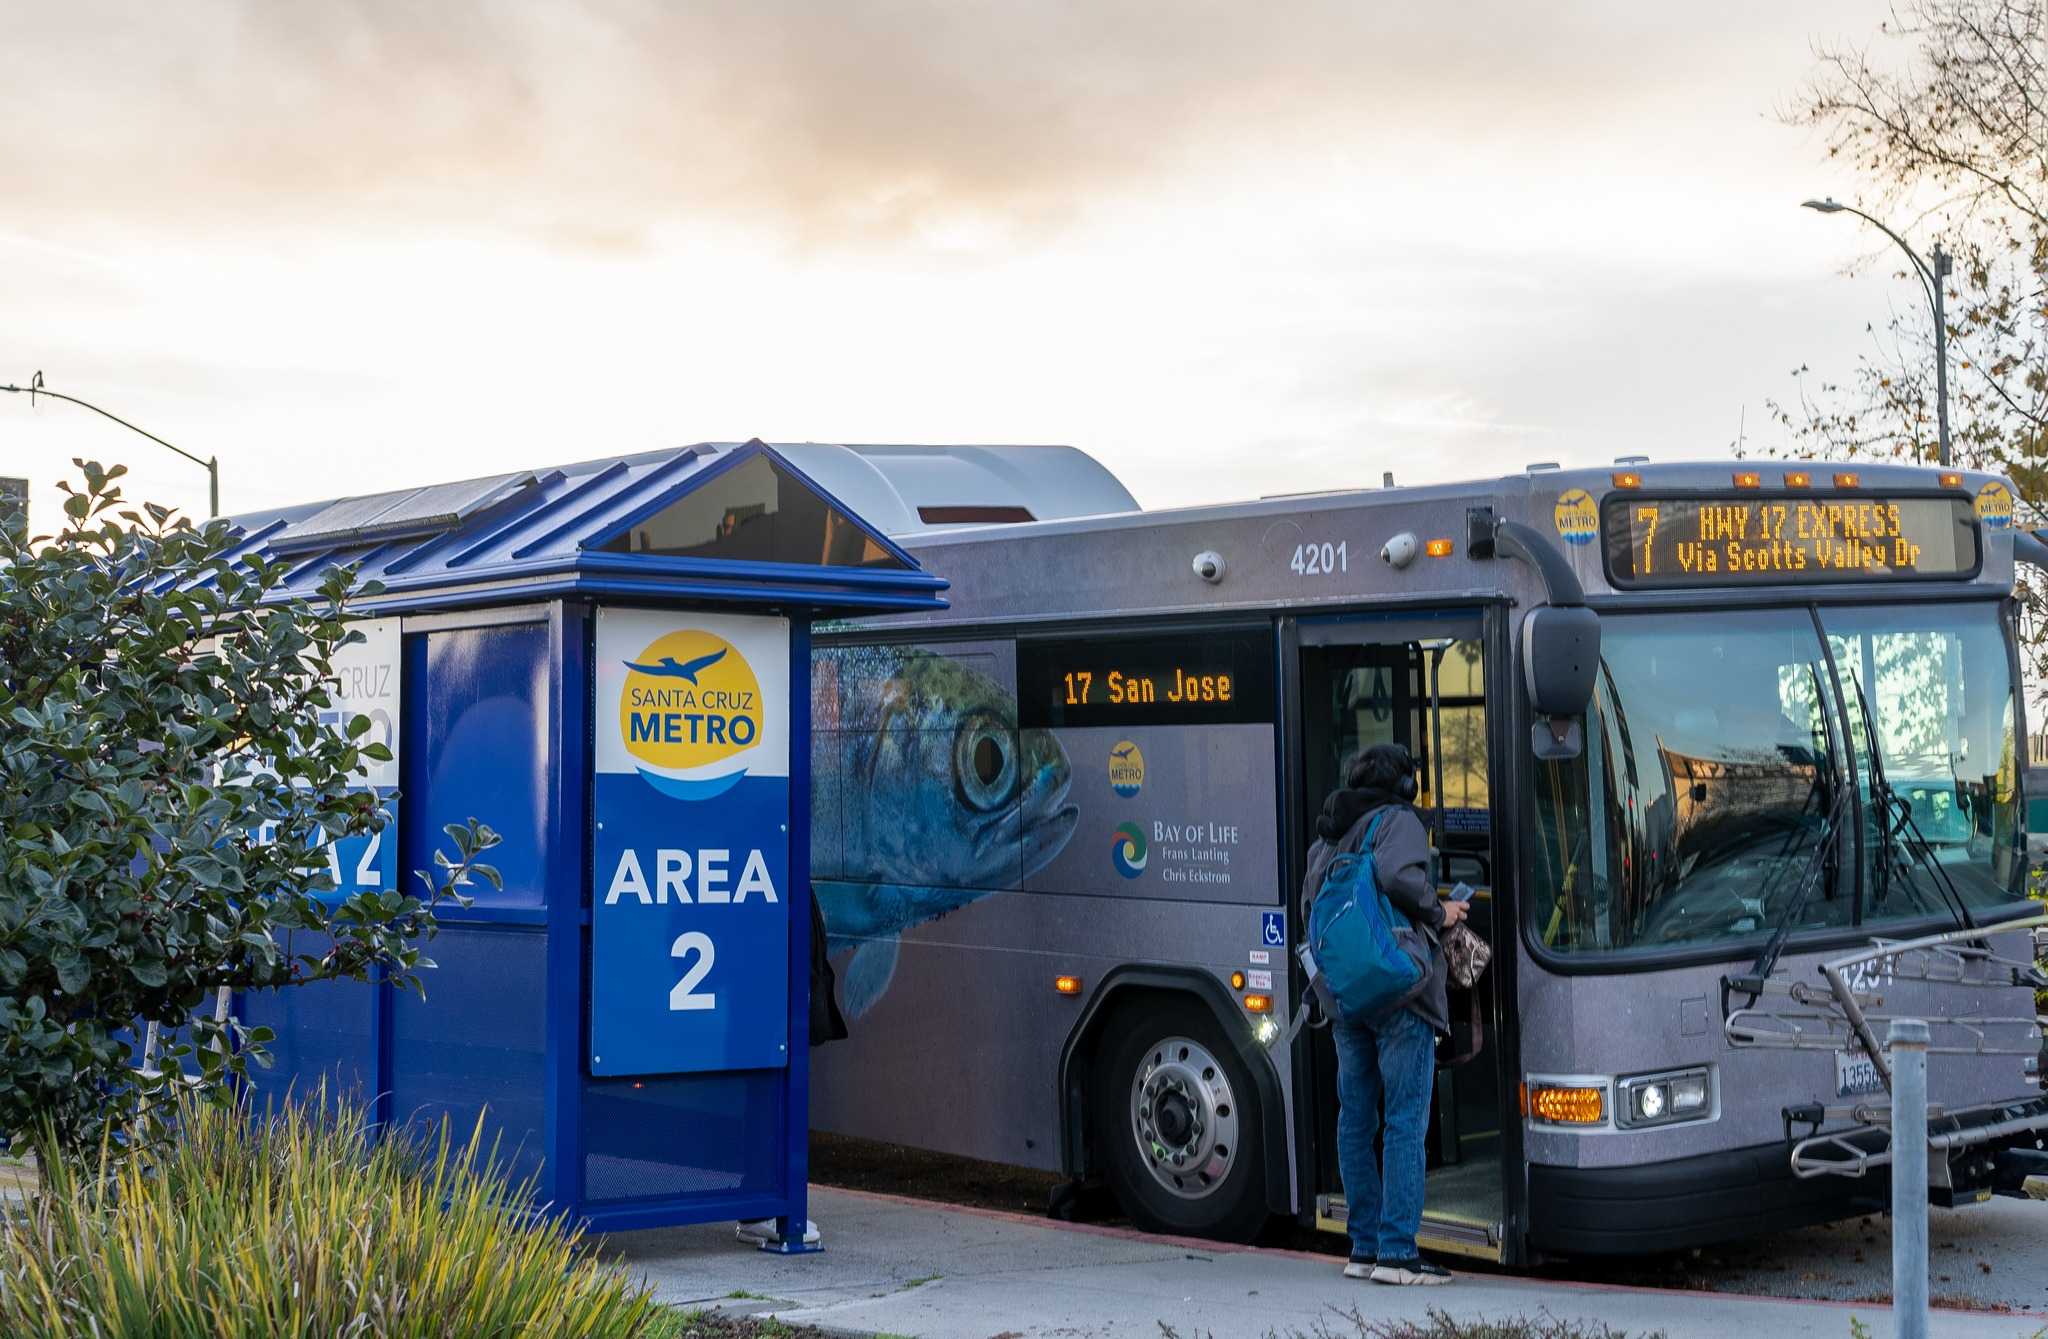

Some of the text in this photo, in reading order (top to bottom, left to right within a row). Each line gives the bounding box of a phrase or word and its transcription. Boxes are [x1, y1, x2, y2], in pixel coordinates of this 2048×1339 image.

[1700, 504, 1900, 541] HWY 17 EXPRESS
[1290, 540, 1347, 576] 4201
[1678, 537, 1921, 572] Via Scotts Valley Dr
[338, 663, 391, 700] CRUZ
[631, 688, 753, 710] SANTA CRUZ
[1065, 668, 1232, 704] 17 San Jose
[630, 711, 756, 746] METRO
[1111, 767, 1142, 780] METRO
[1162, 846, 1231, 866] Frans Lanting
[604, 848, 779, 905] AREA
[1162, 867, 1231, 885] Chris Eckstrom
[669, 930, 716, 1011] 2
